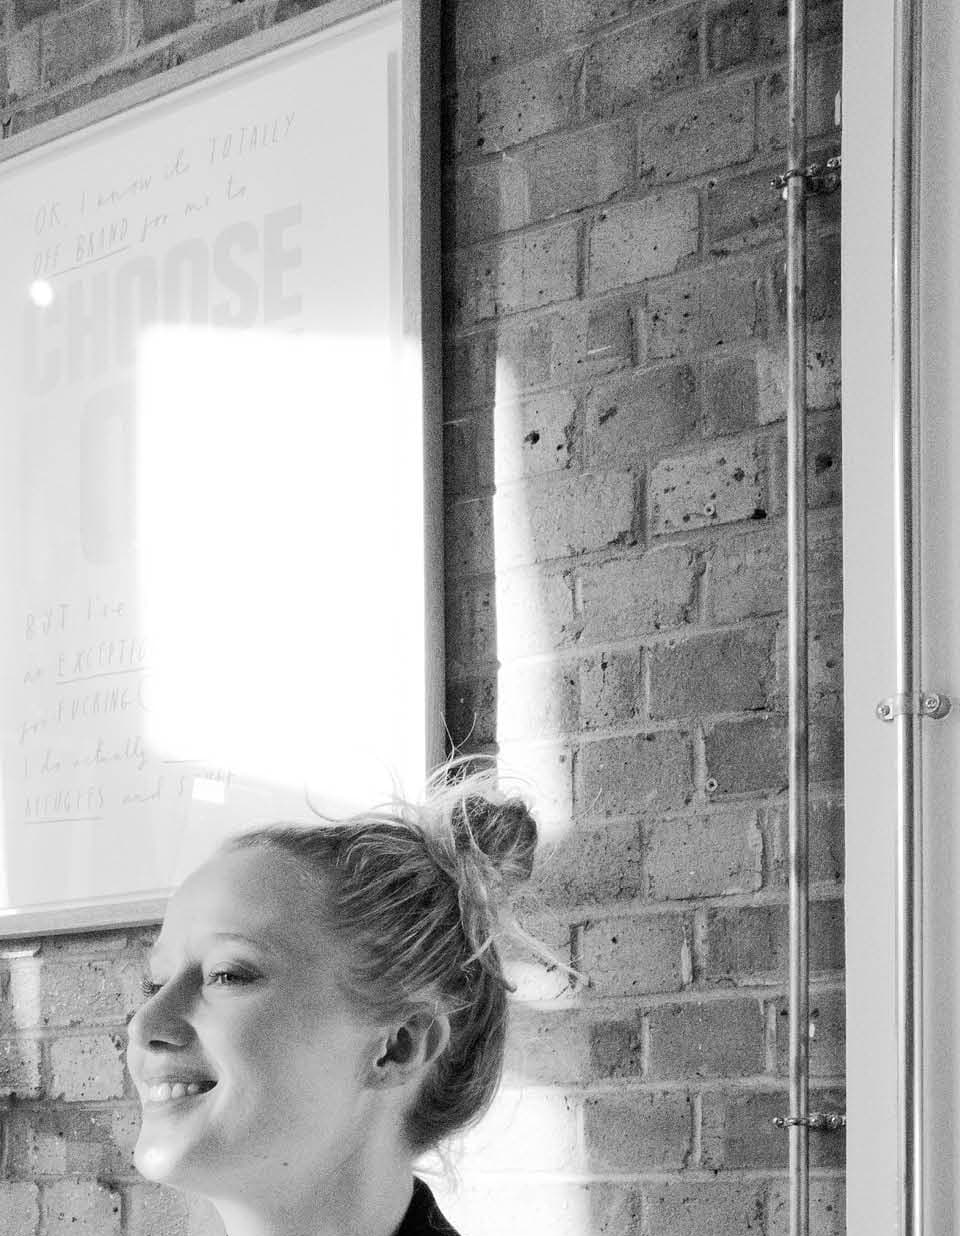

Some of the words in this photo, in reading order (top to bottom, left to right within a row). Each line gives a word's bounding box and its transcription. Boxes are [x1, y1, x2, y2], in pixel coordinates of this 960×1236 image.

[208, 111, 296, 165] TOTALLY
[75, 217, 129, 263] BRAND
[22, 202, 304, 397] CHOOSE
